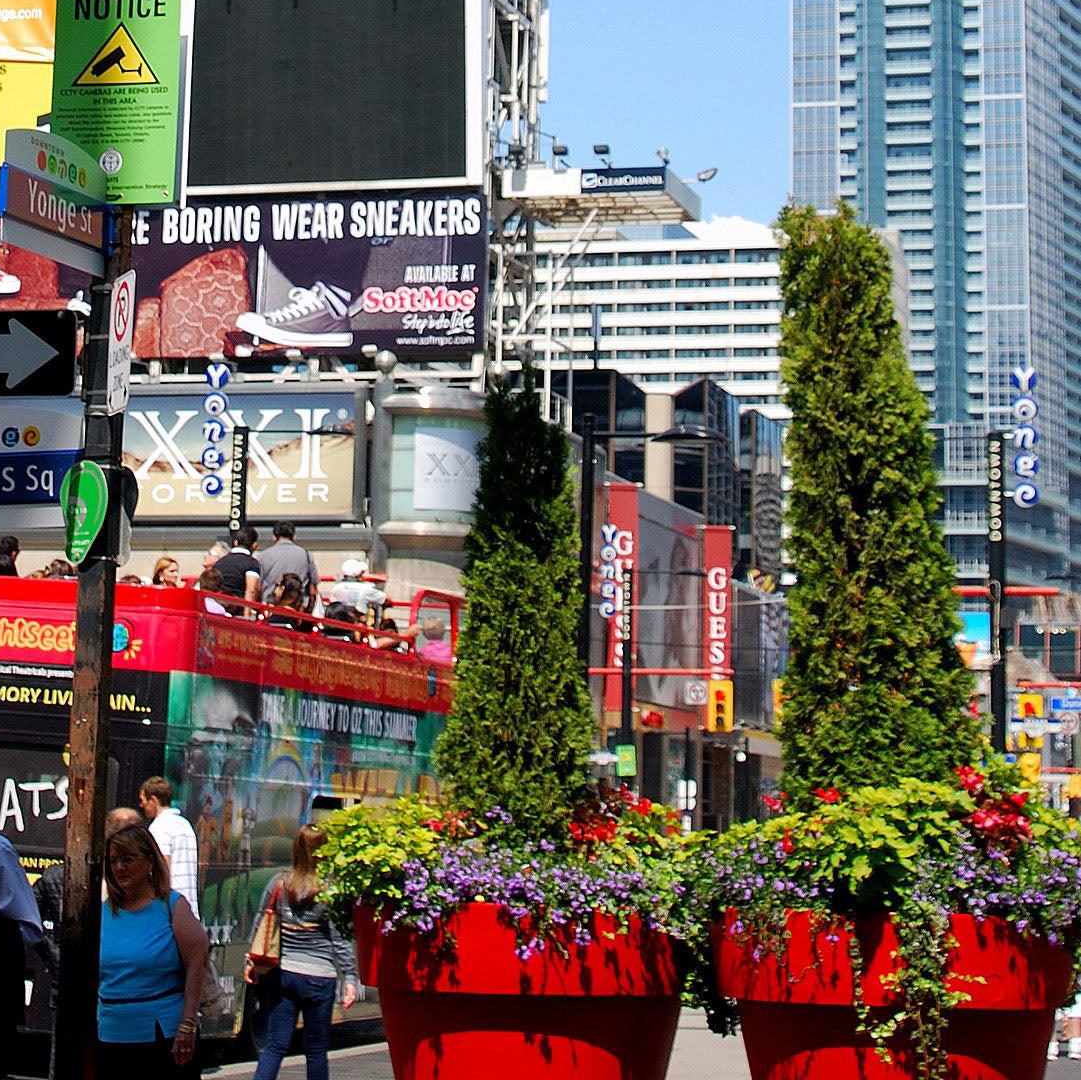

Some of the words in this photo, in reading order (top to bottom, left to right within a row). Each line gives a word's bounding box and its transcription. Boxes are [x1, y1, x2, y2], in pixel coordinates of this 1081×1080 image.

[60, 88, 79, 97] CCTV
[79, 87, 112, 96] CAMERAS
[113, 87, 126, 95] ARE
[128, 86, 149, 94] BEING
[151, 86, 169, 94] USED
[28, 178, 77, 233] Yonge
[80, 206, 92, 234] St
[161, 205, 261, 244] BORING
[271, 202, 345, 241] WEAR
[350, 198, 481, 238] SNEAKERS
[404, 265, 459, 283] AVAILABLE
[461, 264, 476, 282] AT
[362, 286, 476, 313] SoftMoc
[26, 465, 54, 497] Sq
[988, 439, 1003, 542] DOWNTOWN
[296, 698, 337, 732] JOURNEY
[337, 703, 350, 734] TO
[350, 705, 363, 735] OZ
[363, 707, 383, 738] THIS
[383, 711, 418, 743] SUMMER
